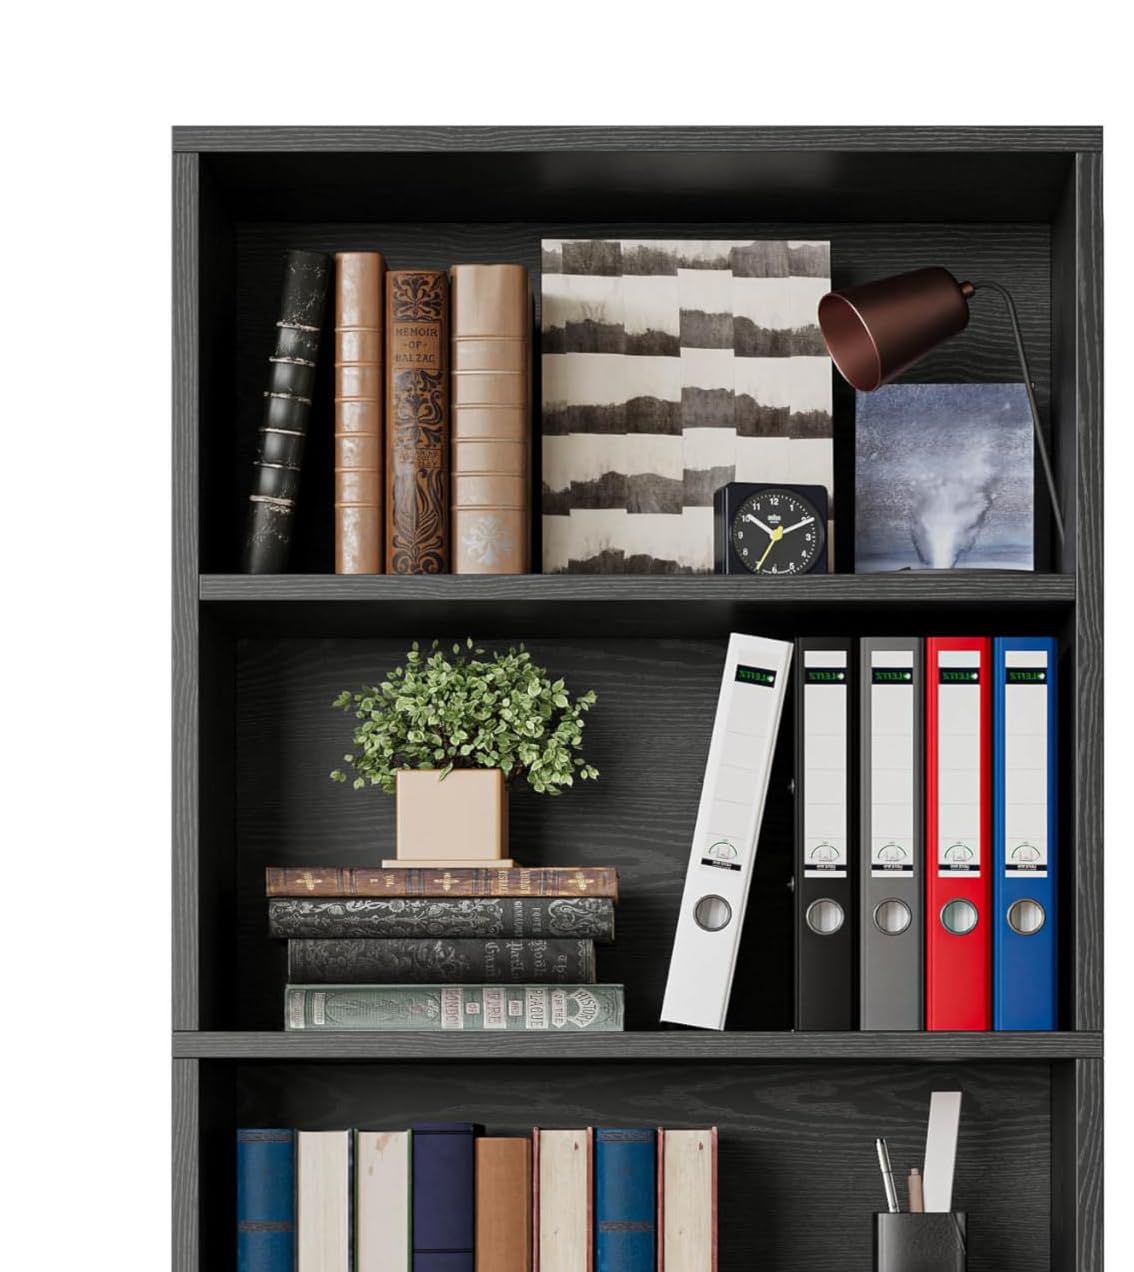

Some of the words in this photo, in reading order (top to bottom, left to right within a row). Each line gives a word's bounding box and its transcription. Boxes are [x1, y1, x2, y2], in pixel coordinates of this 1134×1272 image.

[770, 498, 779, 506] 12
[805, 533, 811, 541] 3
[530, 990, 544, 1027] PLAGUE
[575, 990, 598, 1024] HISTORY
